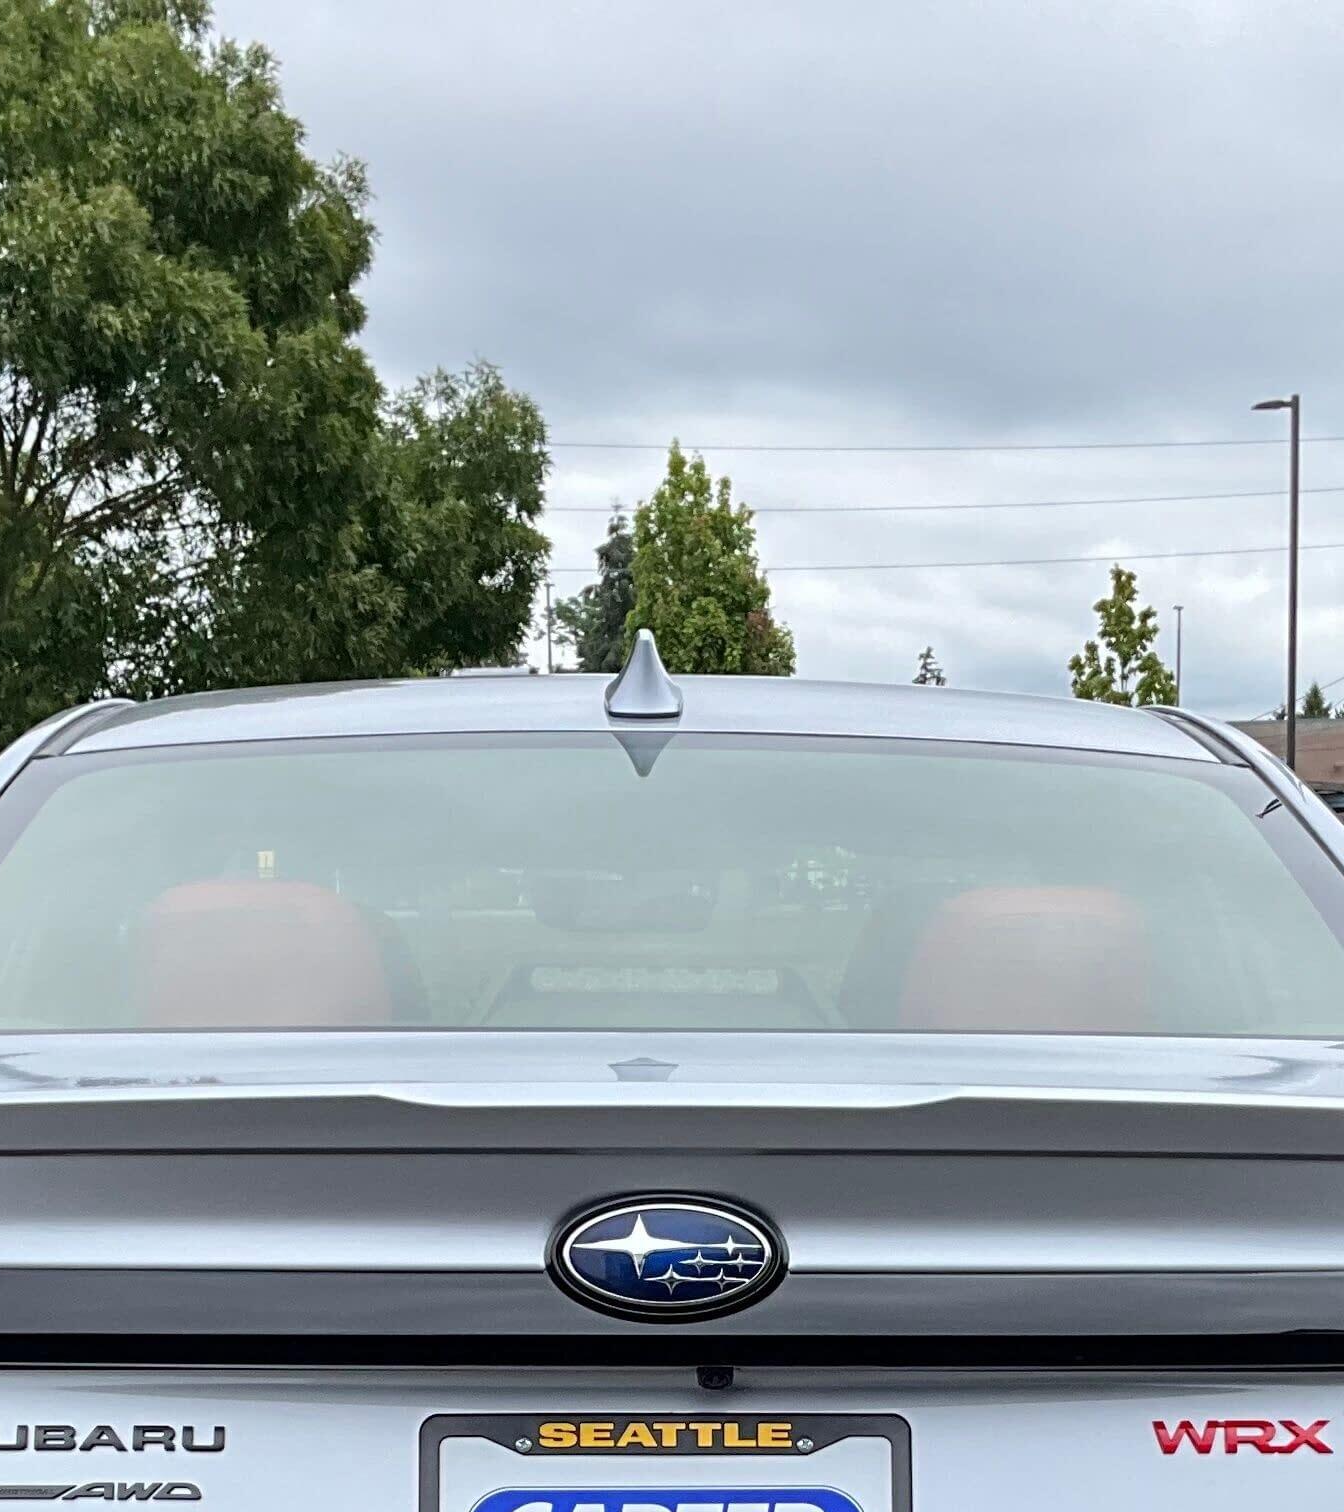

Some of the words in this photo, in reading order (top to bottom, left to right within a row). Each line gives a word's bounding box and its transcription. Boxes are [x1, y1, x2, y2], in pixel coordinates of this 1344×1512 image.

[538, 1421, 793, 1448] SEATTLE
[1152, 1420, 1334, 1454] WRX
[62, 1482, 202, 1500] AWD
